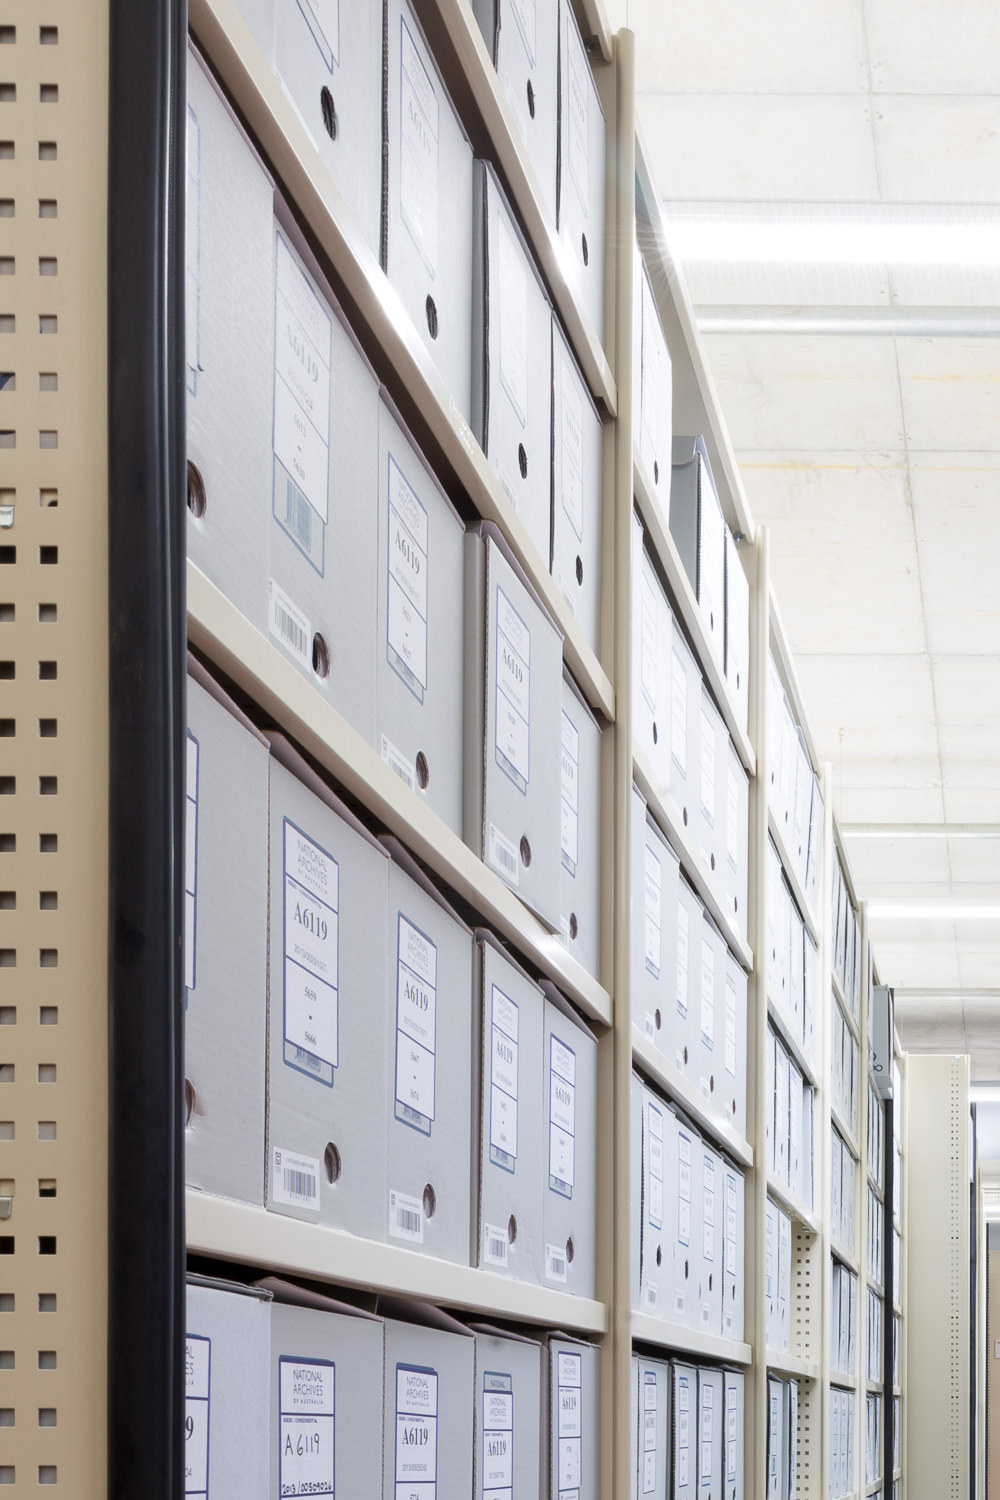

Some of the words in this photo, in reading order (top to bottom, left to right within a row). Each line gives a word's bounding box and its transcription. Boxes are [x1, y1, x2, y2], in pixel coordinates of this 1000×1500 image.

[287, 323, 318, 383] A6119
[395, 530, 420, 575] A6119
[502, 647, 523, 684] A6119
[297, 839, 327, 872] NATIONAL
[297, 854, 327, 886] ARCHIVES
[294, 901, 327, 940] A6119
[404, 980, 428, 1012] A6119
[496, 1040, 512, 1064] A6119
[555, 1085, 570, 1106] A6119
[293, 1370, 323, 1383] NATIONAL
[407, 1377, 429, 1388] NATIONAL
[293, 1385, 323, 1396] ARCHIVES
[406, 1389, 429, 1400] ARCHIVES
[561, 1397, 576, 1410] A6119
[285, 1433, 319, 1456] A6119
[402, 1427, 428, 1445] A6119
[487, 1441, 506, 1456] A6119
